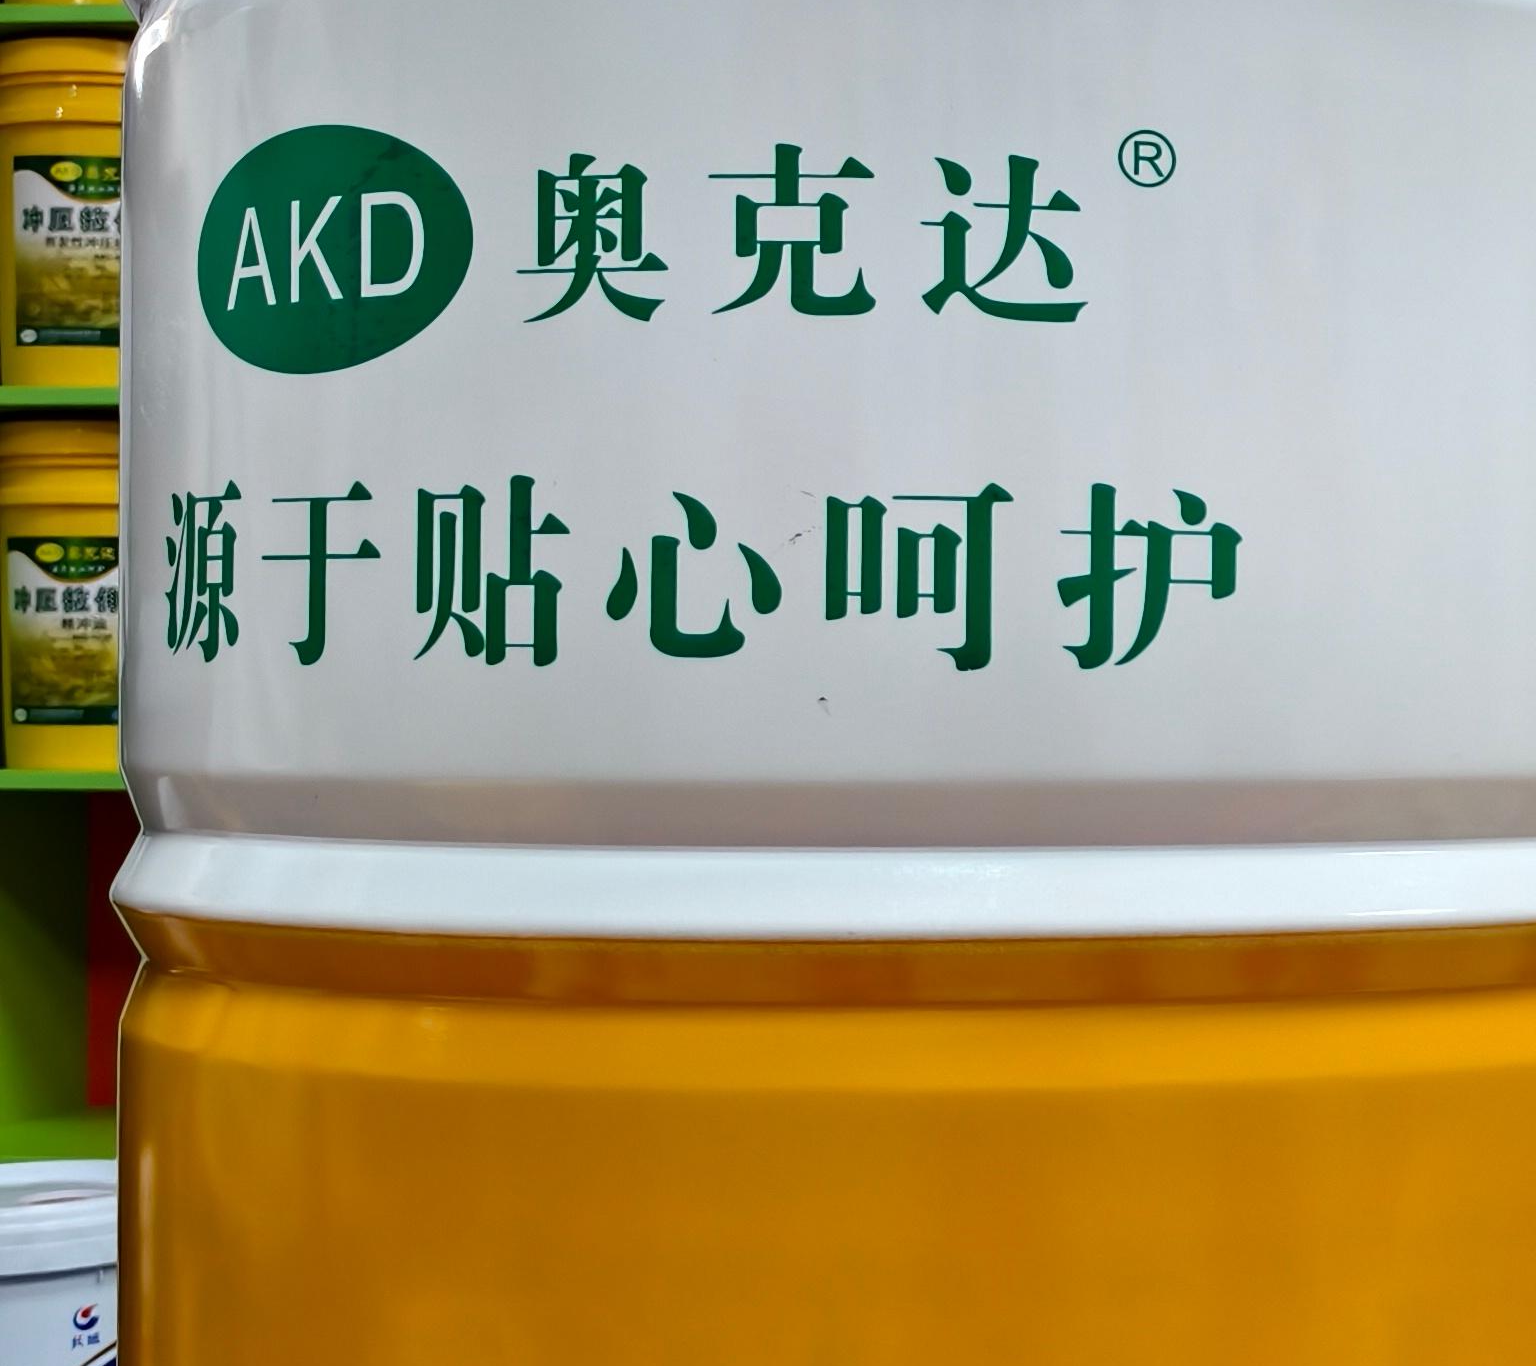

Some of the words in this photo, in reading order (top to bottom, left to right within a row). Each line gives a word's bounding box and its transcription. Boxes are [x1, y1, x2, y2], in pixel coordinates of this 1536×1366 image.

[227, 189, 425, 311] AKD
[516, 143, 1089, 323] 奥克达
[164, 475, 1244, 672] 源于贴心呵护
